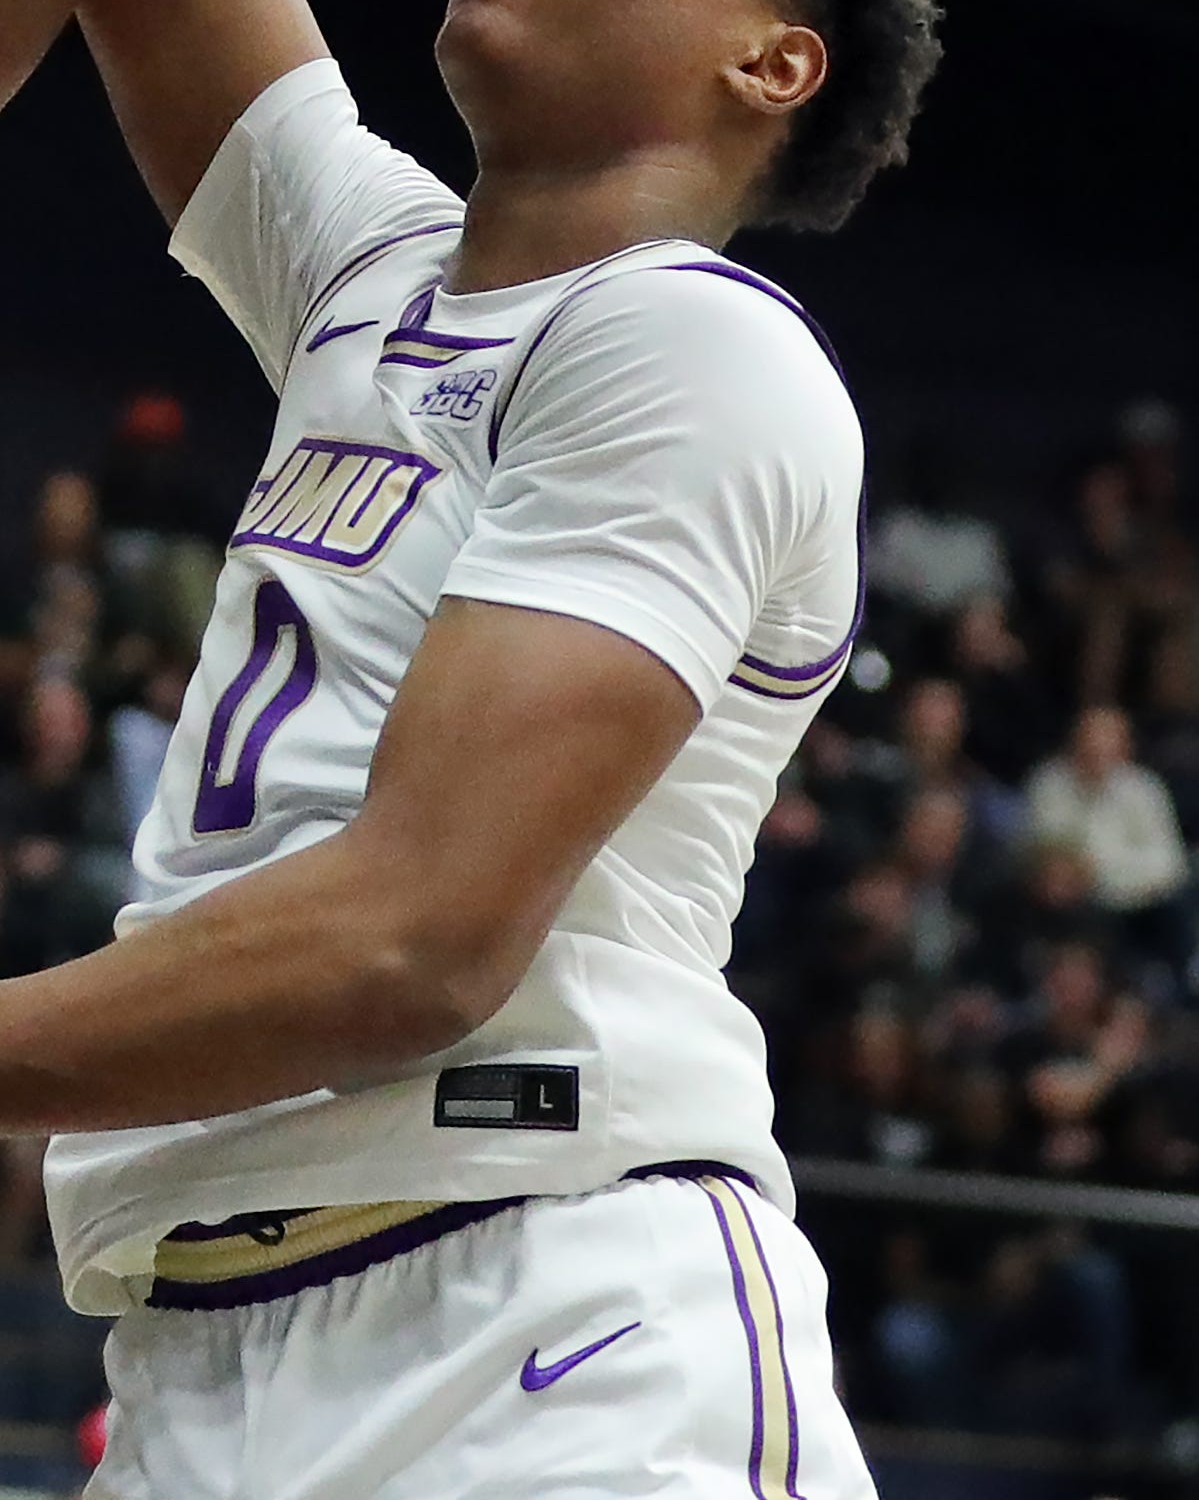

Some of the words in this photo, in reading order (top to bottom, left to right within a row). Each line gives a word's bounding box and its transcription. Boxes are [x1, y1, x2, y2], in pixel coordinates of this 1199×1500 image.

[230, 440, 434, 564] JMU
[193, 576, 319, 838] 0
[539, 1083, 554, 1109] L
